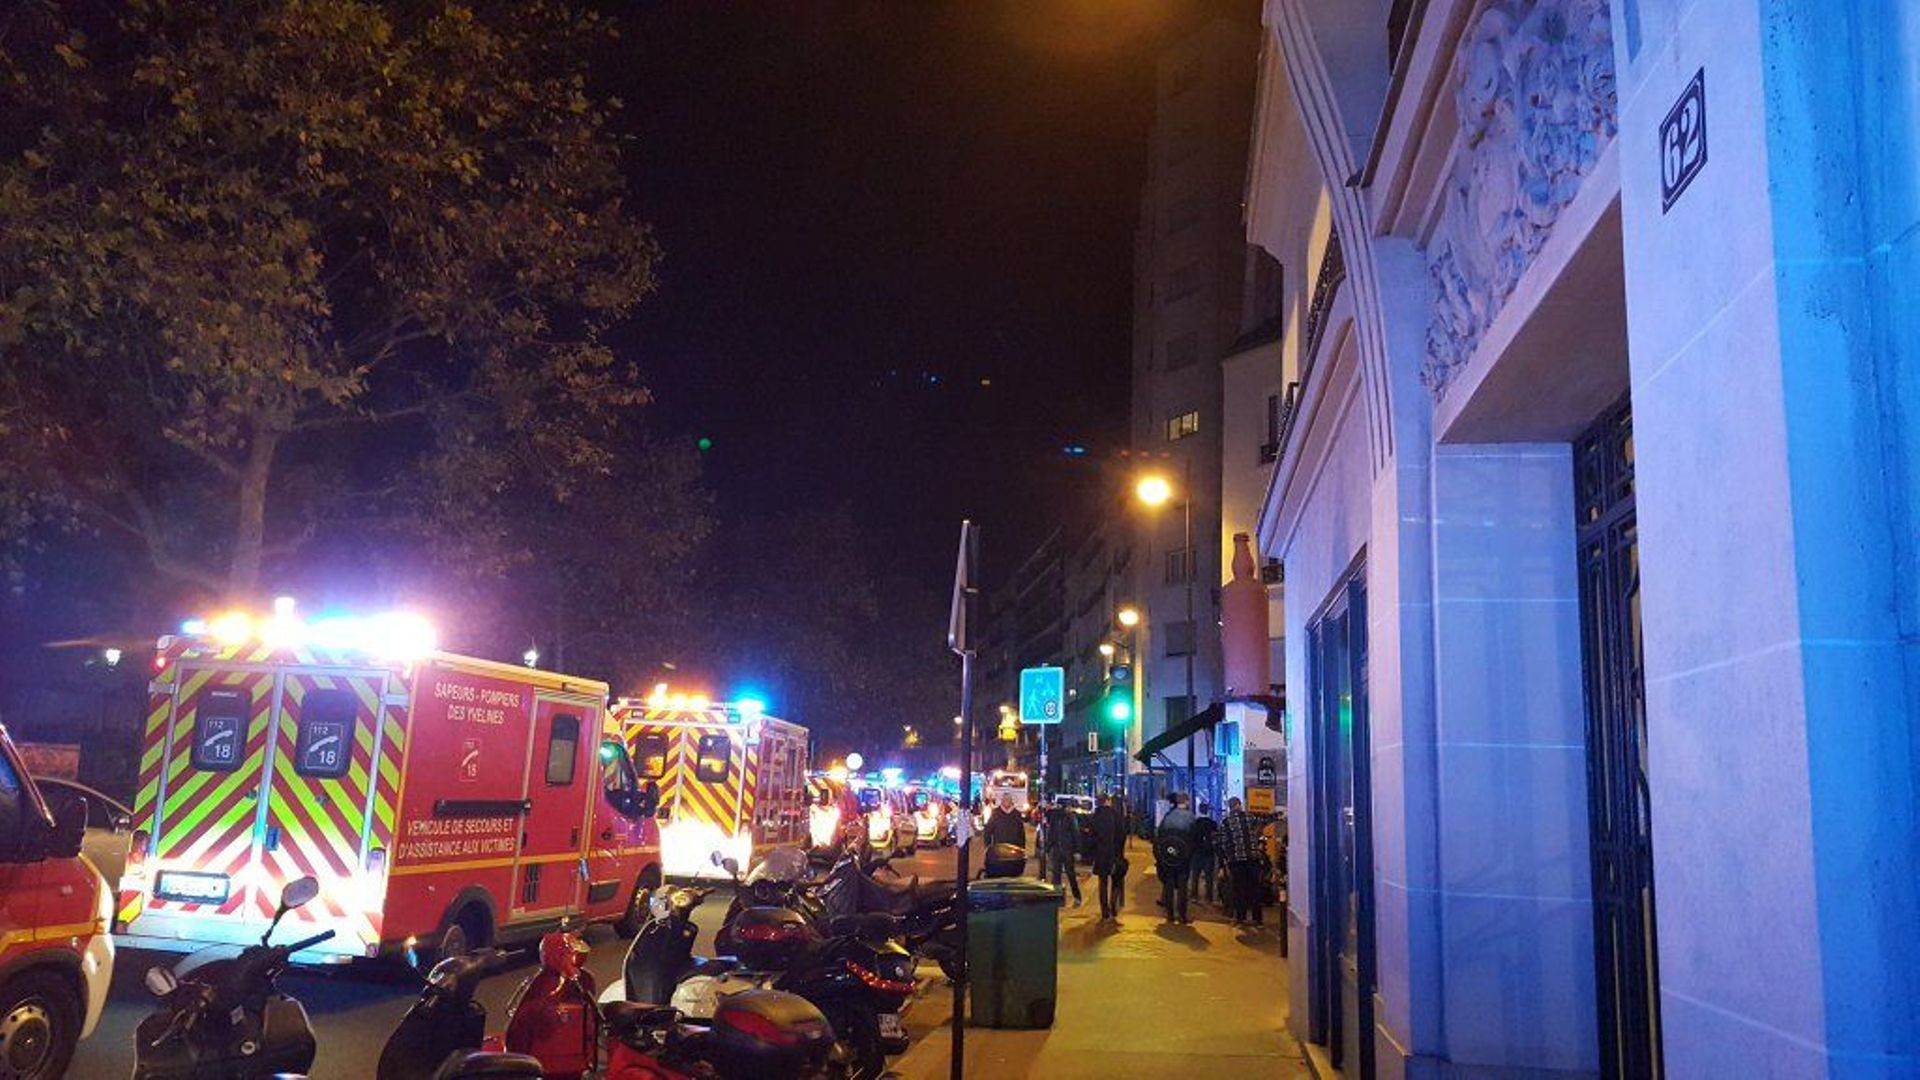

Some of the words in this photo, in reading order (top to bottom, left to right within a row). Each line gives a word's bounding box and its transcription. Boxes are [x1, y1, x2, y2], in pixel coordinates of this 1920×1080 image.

[1664, 96, 1700, 189] 62
[434, 682, 475, 701] SAPEURS
[481, 688, 520, 708] POMPIERS
[447, 704, 465, 720] DES
[468, 707, 504, 725] YVELINES
[208, 720, 224, 729] 112
[313, 726, 329, 735] 112
[214, 744, 231, 759] 18
[319, 751, 336, 765] 18
[451, 819, 464, 834] DE
[465, 818, 503, 834] SECOURS
[503, 818, 514, 832] ET
[398, 840, 460, 859] D'ASSISTANCE
[462, 839, 480, 854] AUX
[481, 837, 516, 853] VICTIMES
